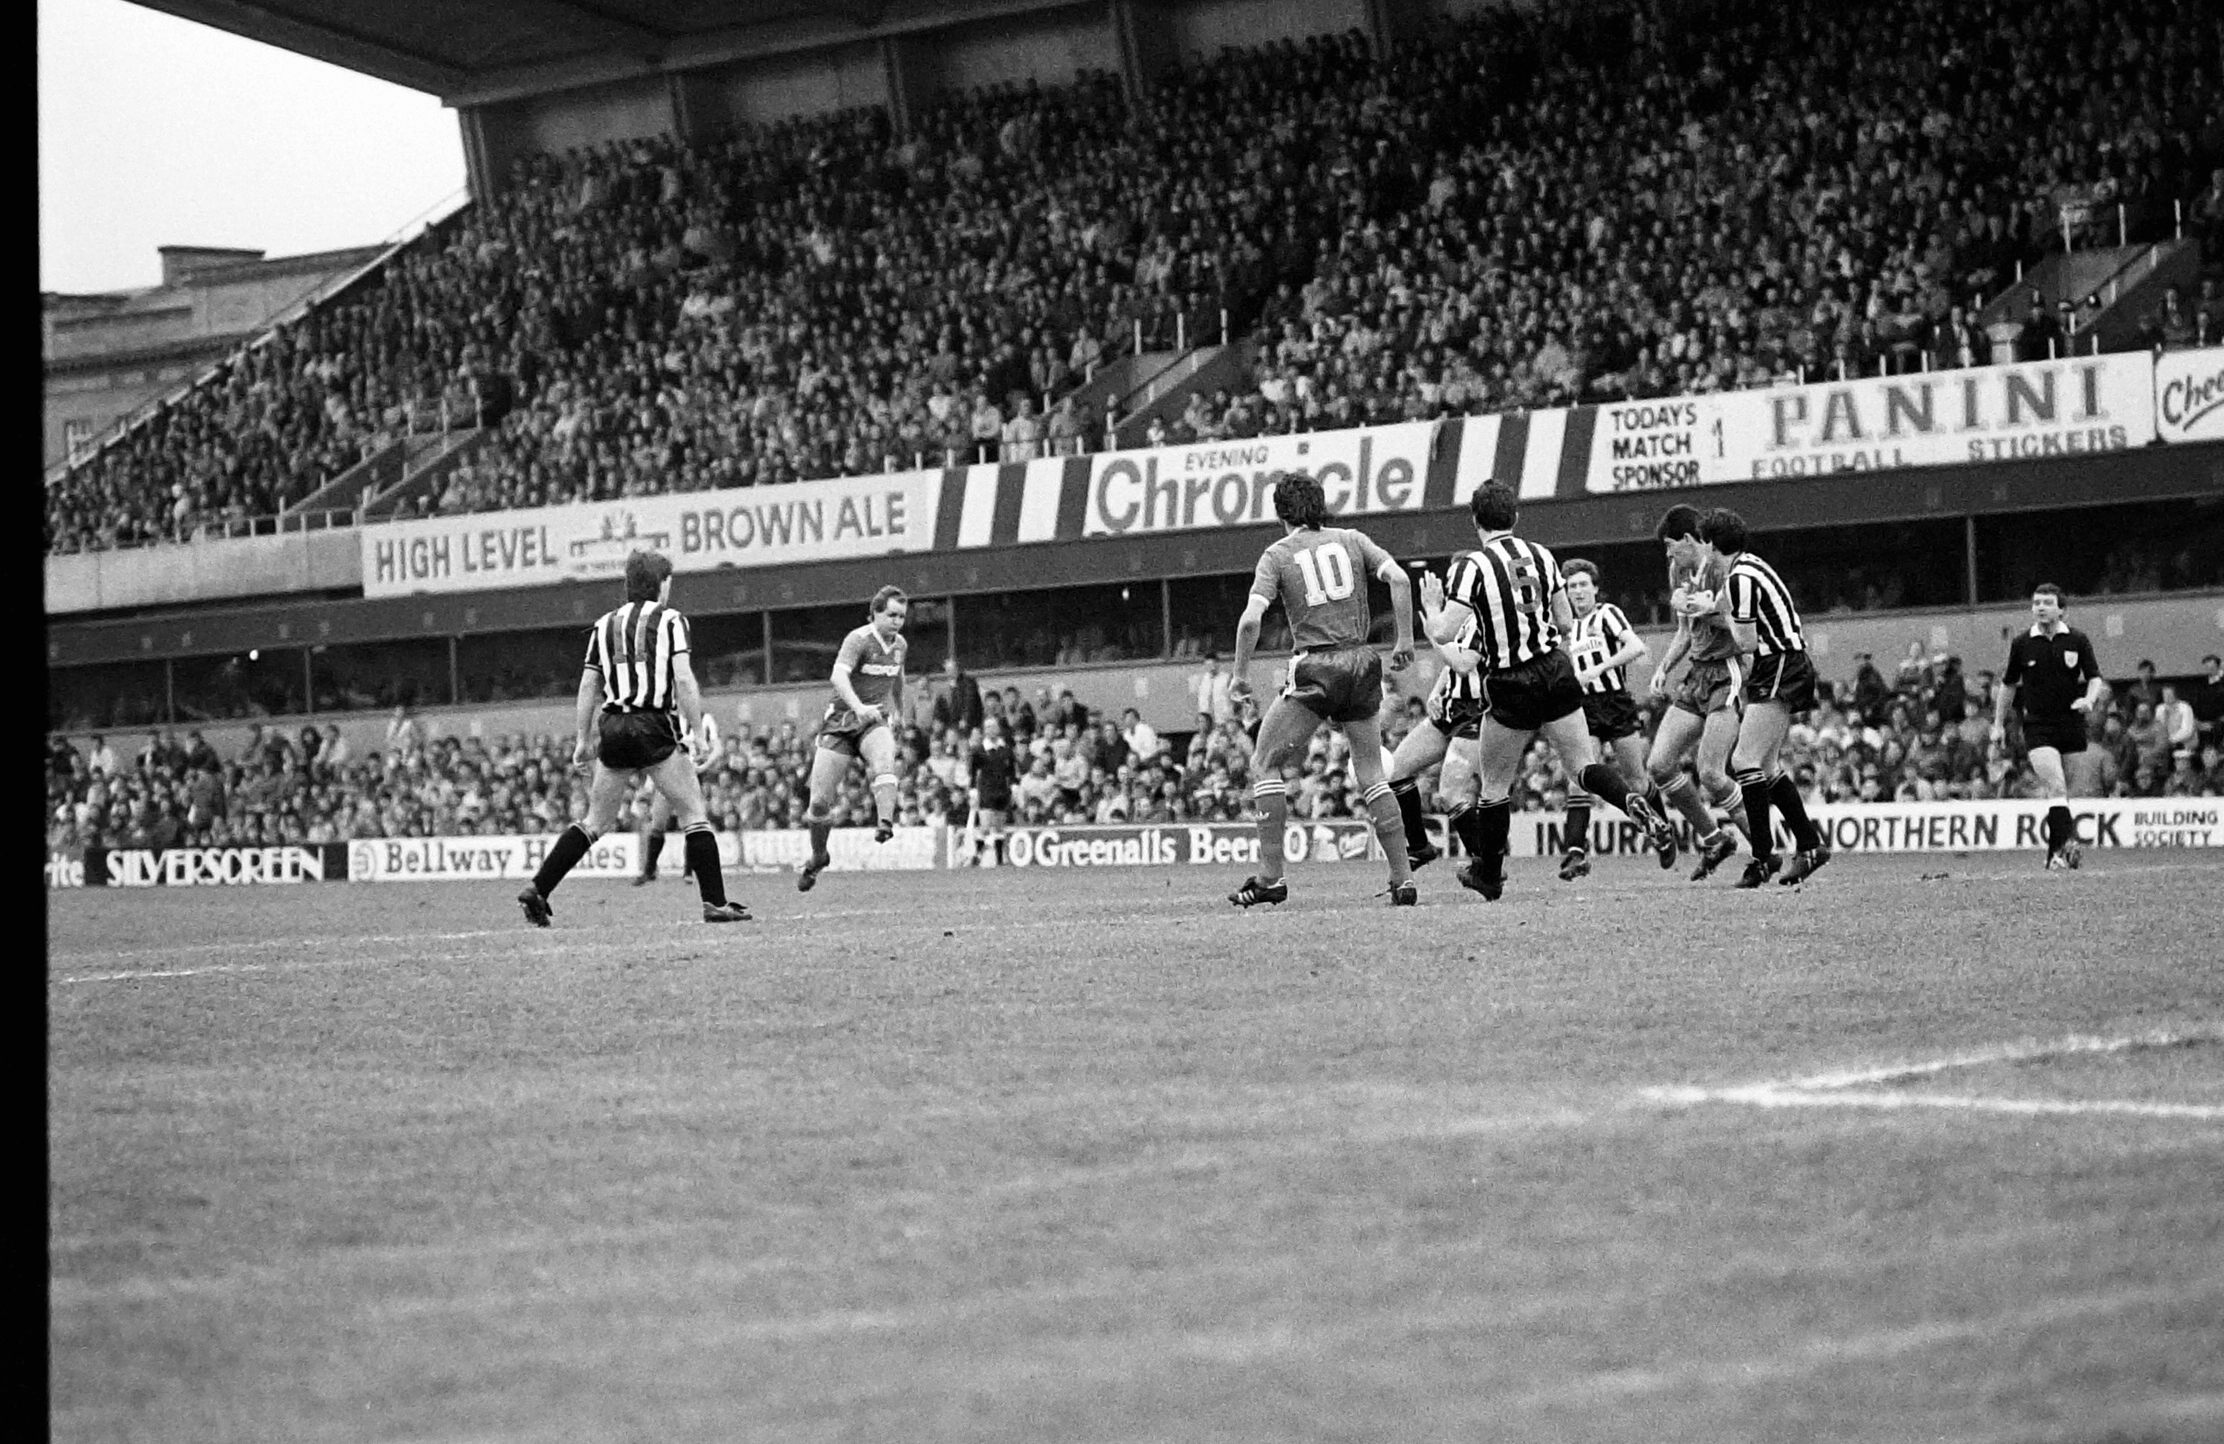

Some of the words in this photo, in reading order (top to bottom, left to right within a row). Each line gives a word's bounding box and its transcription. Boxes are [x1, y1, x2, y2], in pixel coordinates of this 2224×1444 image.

[1611, 402, 1698, 432] TODAYS
[1767, 359, 2106, 452] PANINI
[1184, 445, 1269, 470] EVENING
[1612, 432, 1692, 460] MATCH
[1751, 448, 1914, 481] FOOTBALL
[1968, 424, 2130, 463] STICKERS
[1612, 460, 1702, 491] SPONSOR
[681, 502, 824, 553] BROWN
[833, 491, 906, 541] ALE
[376, 537, 451, 583] HIGH
[462, 525, 558, 572] LEVEL
[1293, 542, 1355, 608] 10
[1507, 556, 1543, 614] 5
[1811, 813, 1999, 848] NORTHERN
[2134, 810, 2219, 827] BUILDING
[1536, 819, 1735, 857] INURN
[2134, 830, 2213, 850] SOCIETY
[384, 841, 512, 877] Bellway
[522, 838, 627, 871] Hes
